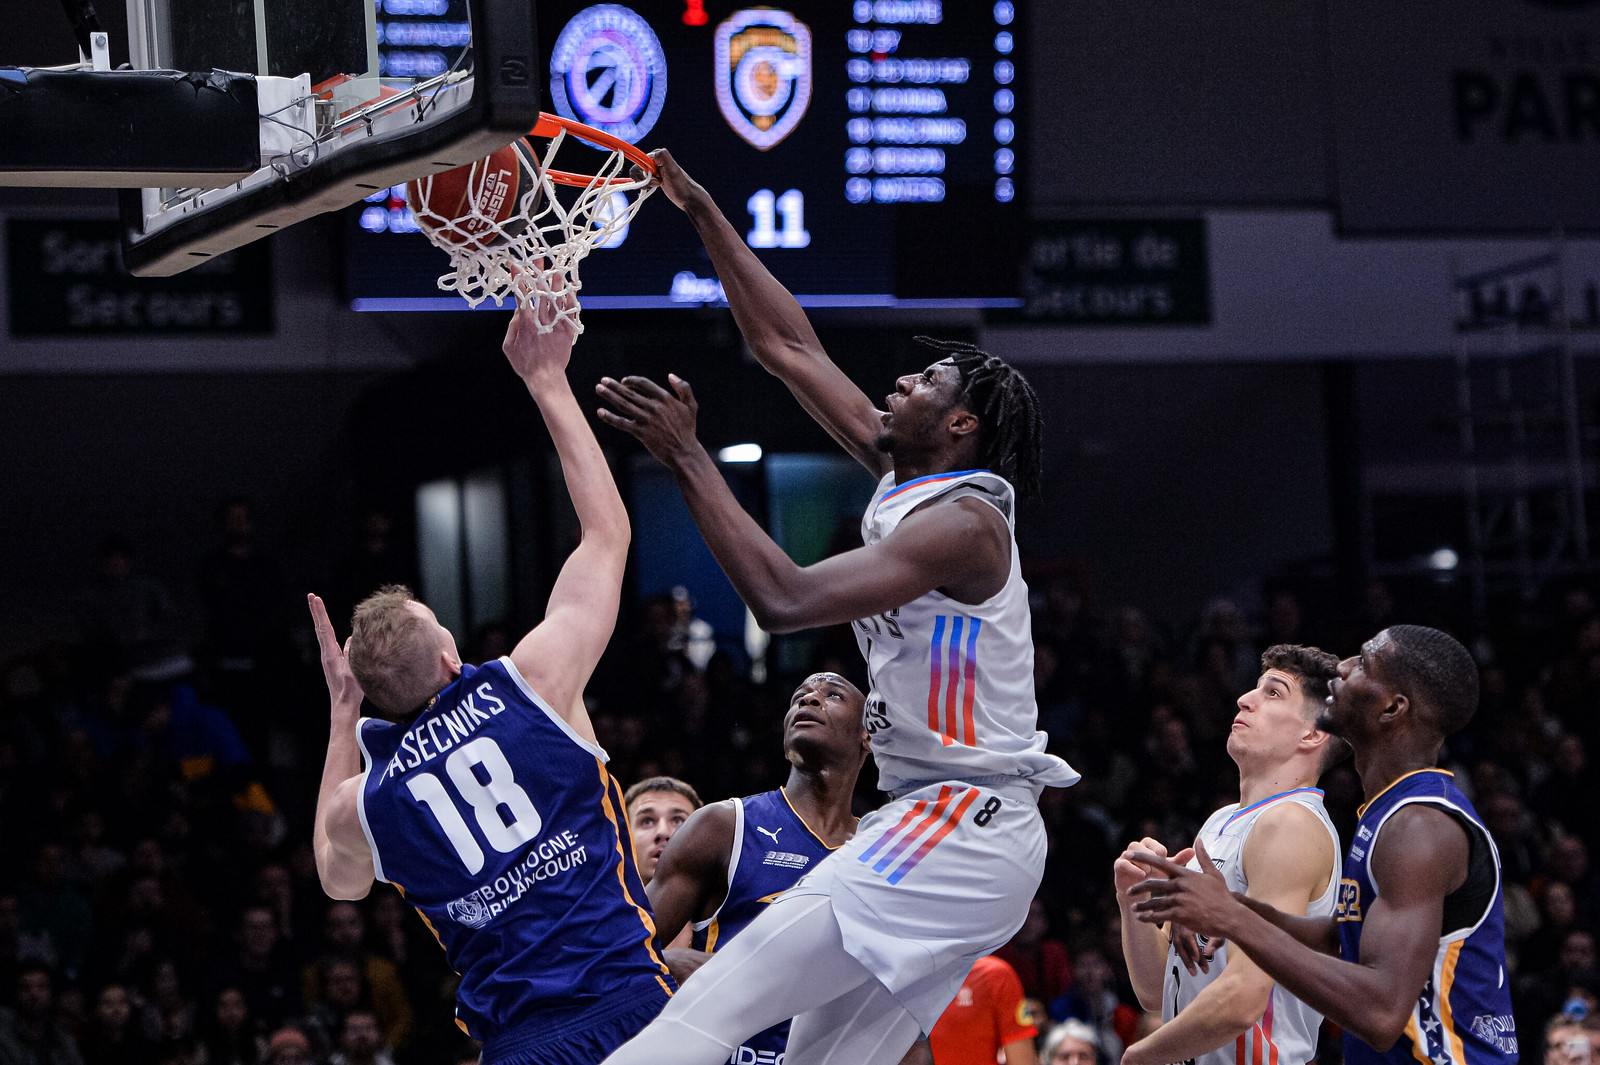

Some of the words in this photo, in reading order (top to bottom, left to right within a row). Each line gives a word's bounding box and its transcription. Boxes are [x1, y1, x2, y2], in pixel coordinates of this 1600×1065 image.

[747, 188, 811, 248] 11
[1031, 230, 1122, 268] ortie
[379, 681, 506, 787] ASECNIKS
[405, 736, 541, 876] 18
[973, 795, 1002, 828] 8
